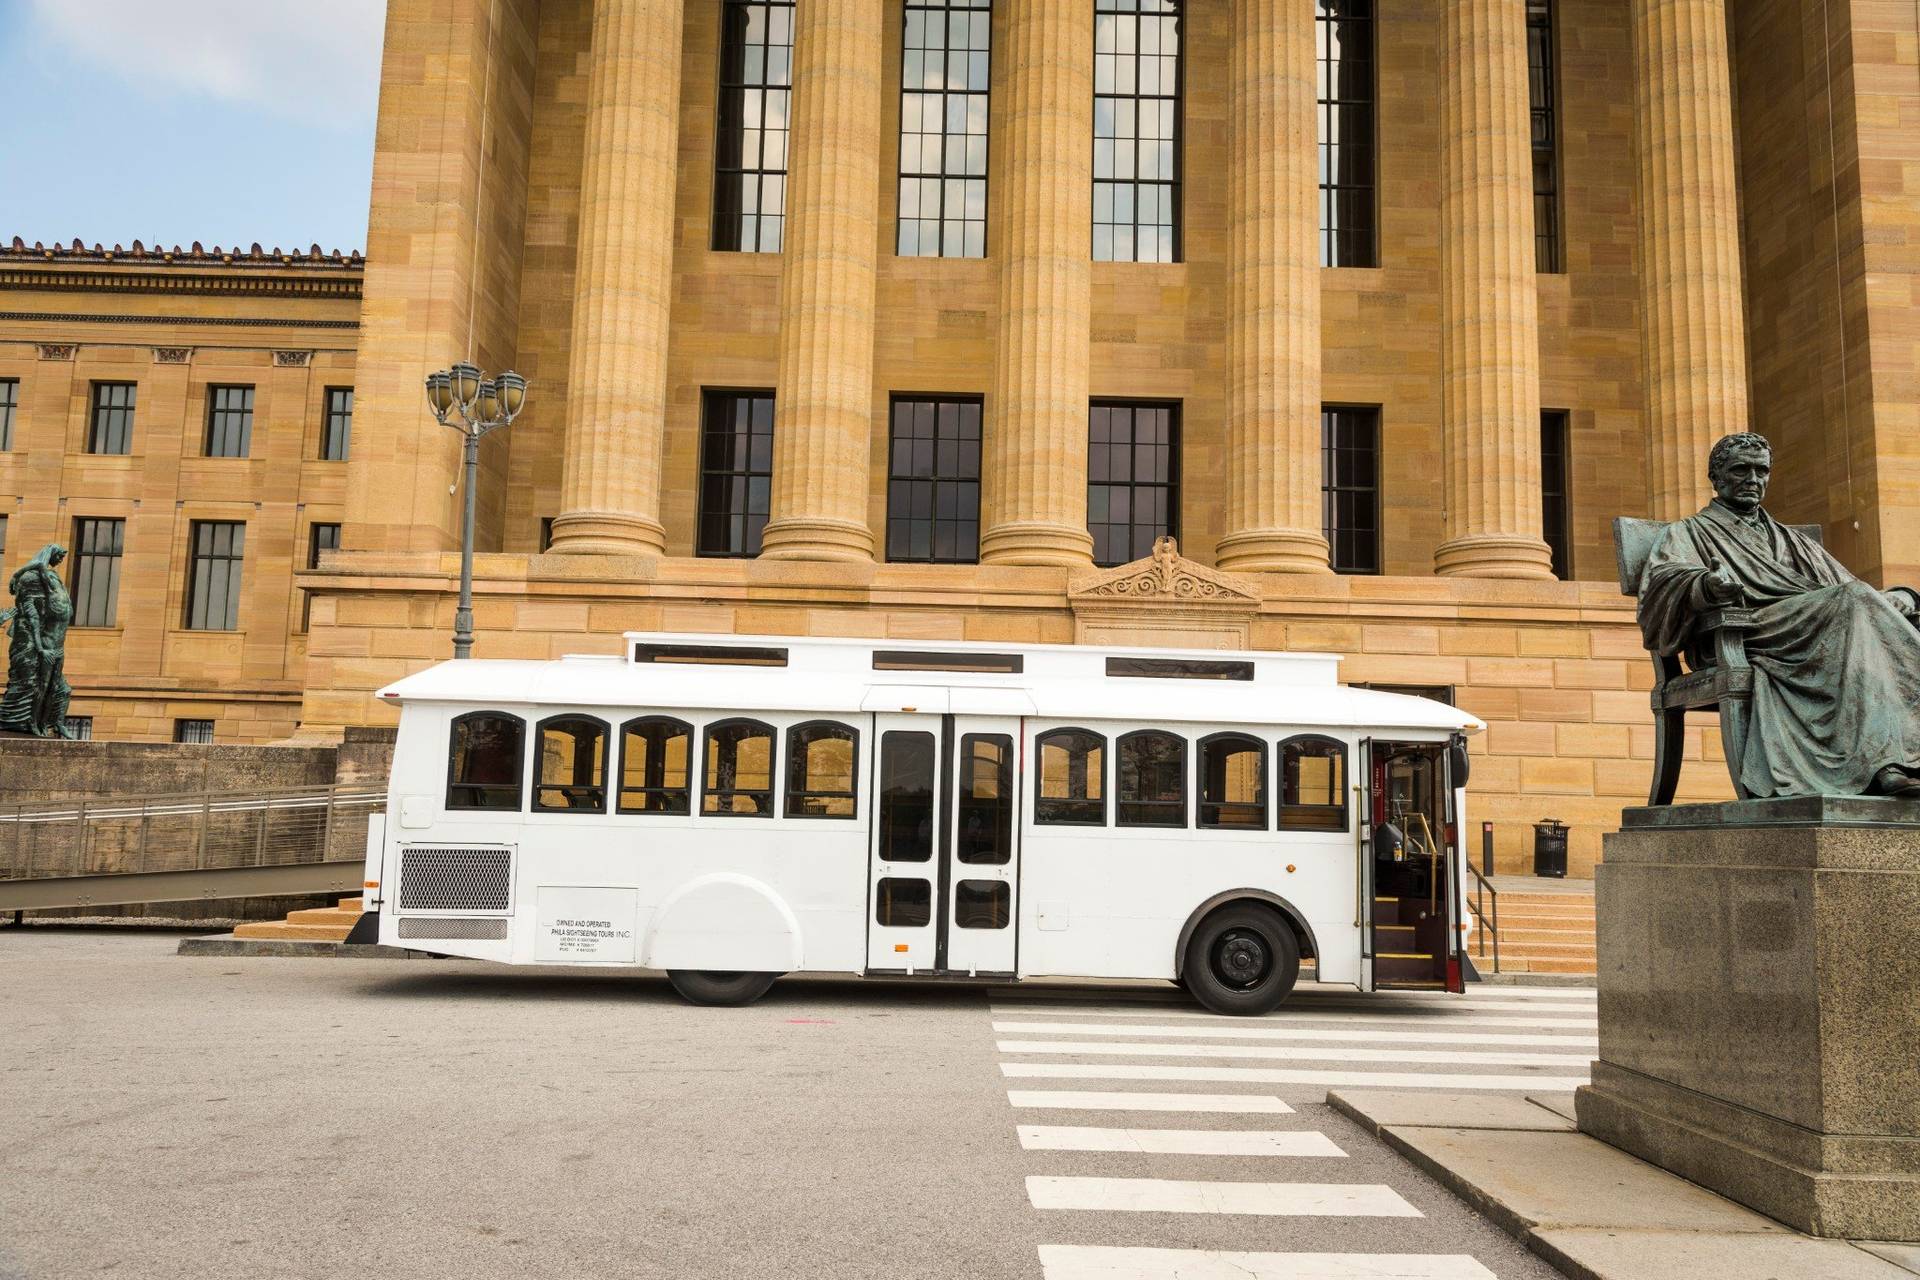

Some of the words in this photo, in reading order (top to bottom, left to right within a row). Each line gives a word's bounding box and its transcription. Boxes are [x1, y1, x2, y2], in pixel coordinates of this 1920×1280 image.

[556, 919, 574, 927] OWNED
[586, 920, 611, 928] OPERATED
[566, 929, 597, 937] SIGHTSEEING
[598, 930, 614, 938] TOURS
